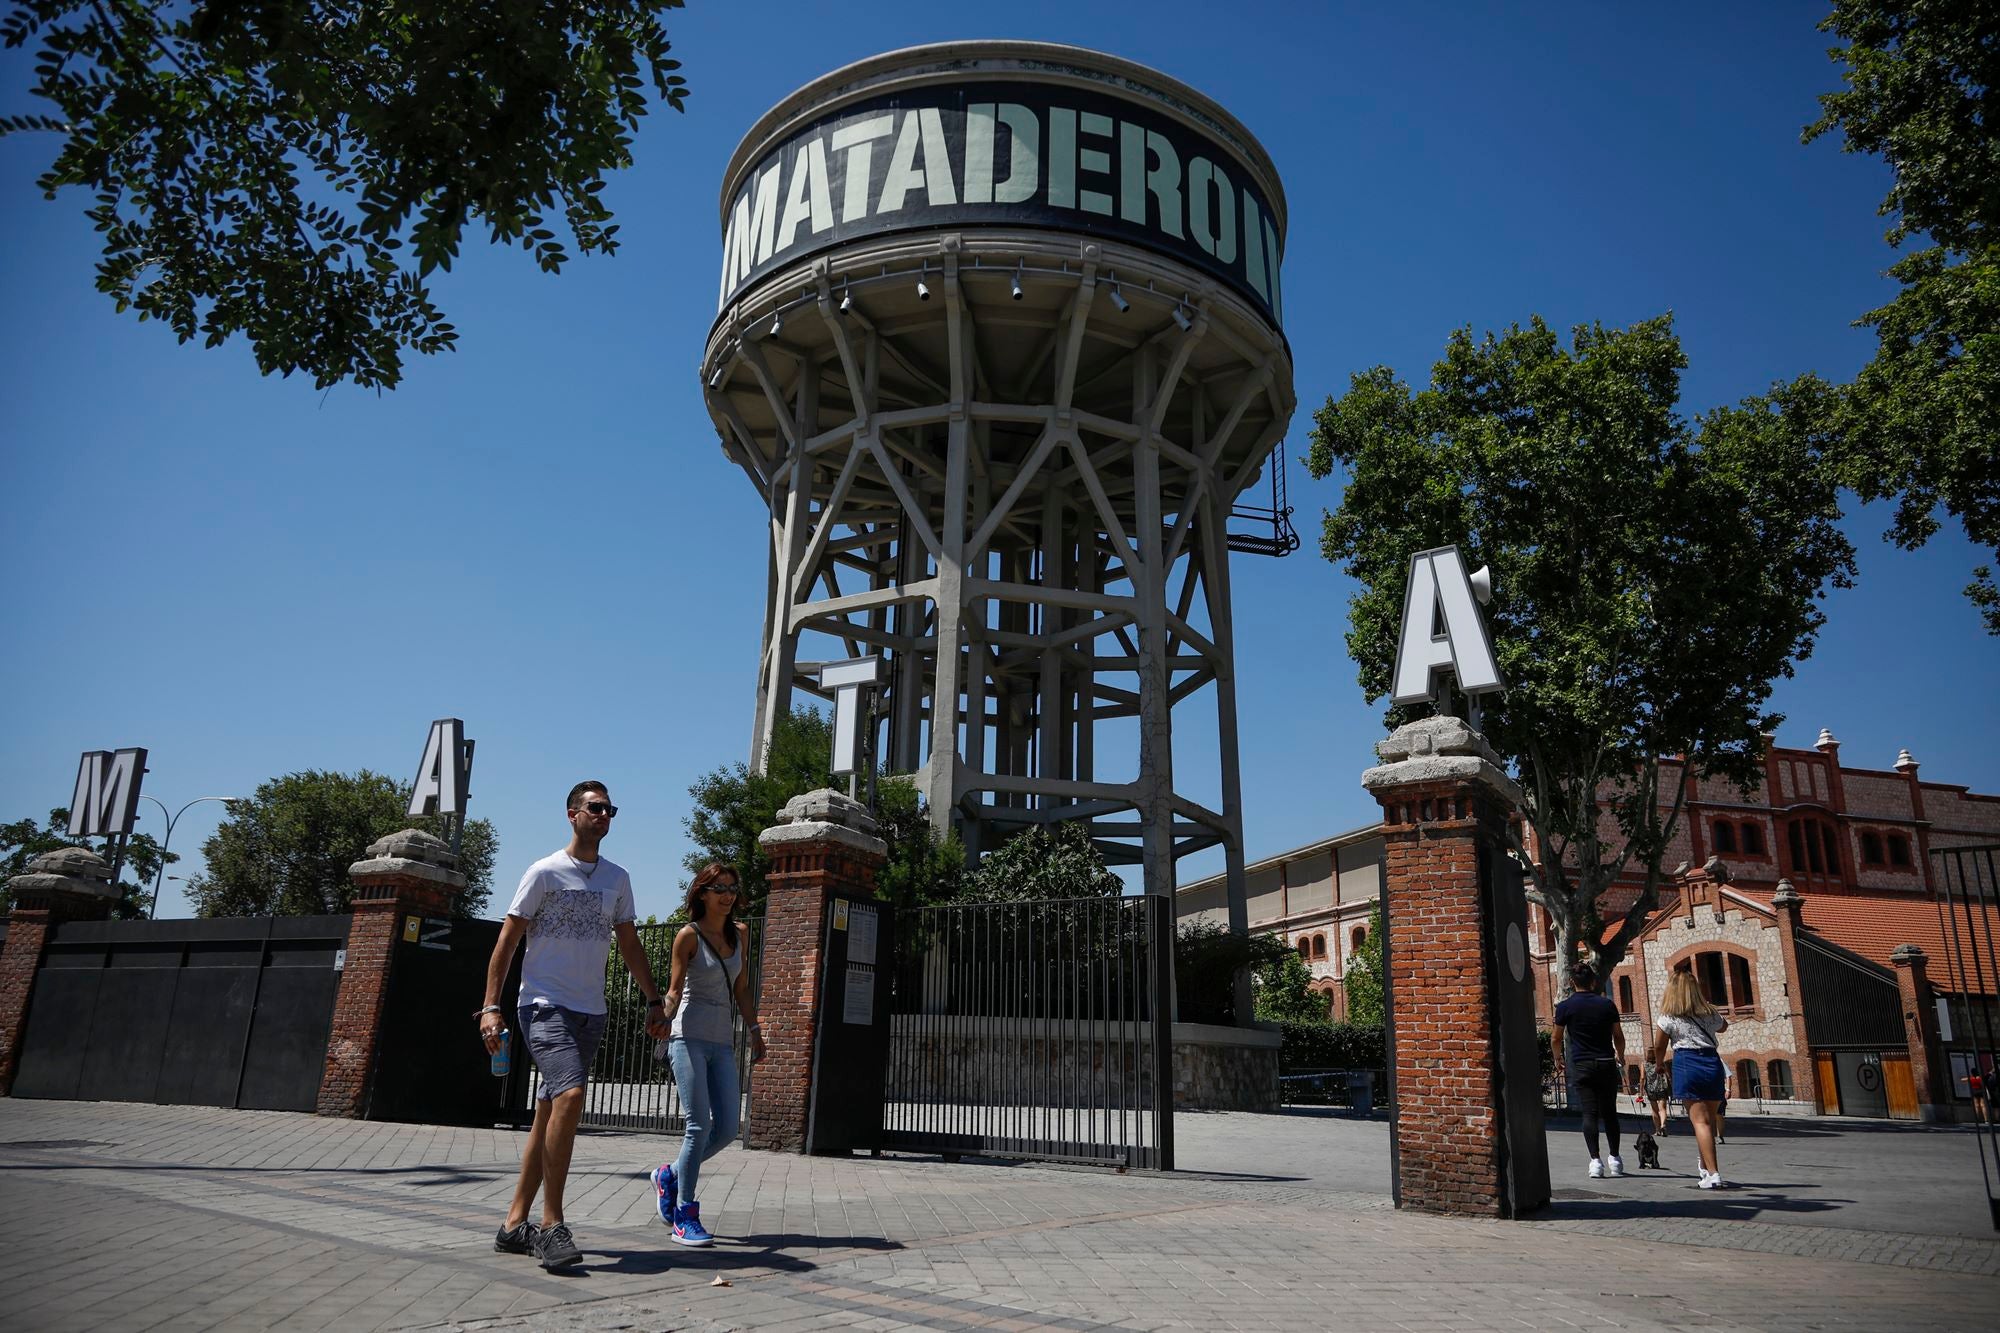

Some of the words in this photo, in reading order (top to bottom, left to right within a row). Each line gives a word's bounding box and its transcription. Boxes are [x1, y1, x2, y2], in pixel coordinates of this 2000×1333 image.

[1393, 544, 1503, 702] A
[407, 718, 463, 815] A
[818, 655, 881, 774] T
[66, 747, 145, 836] M
